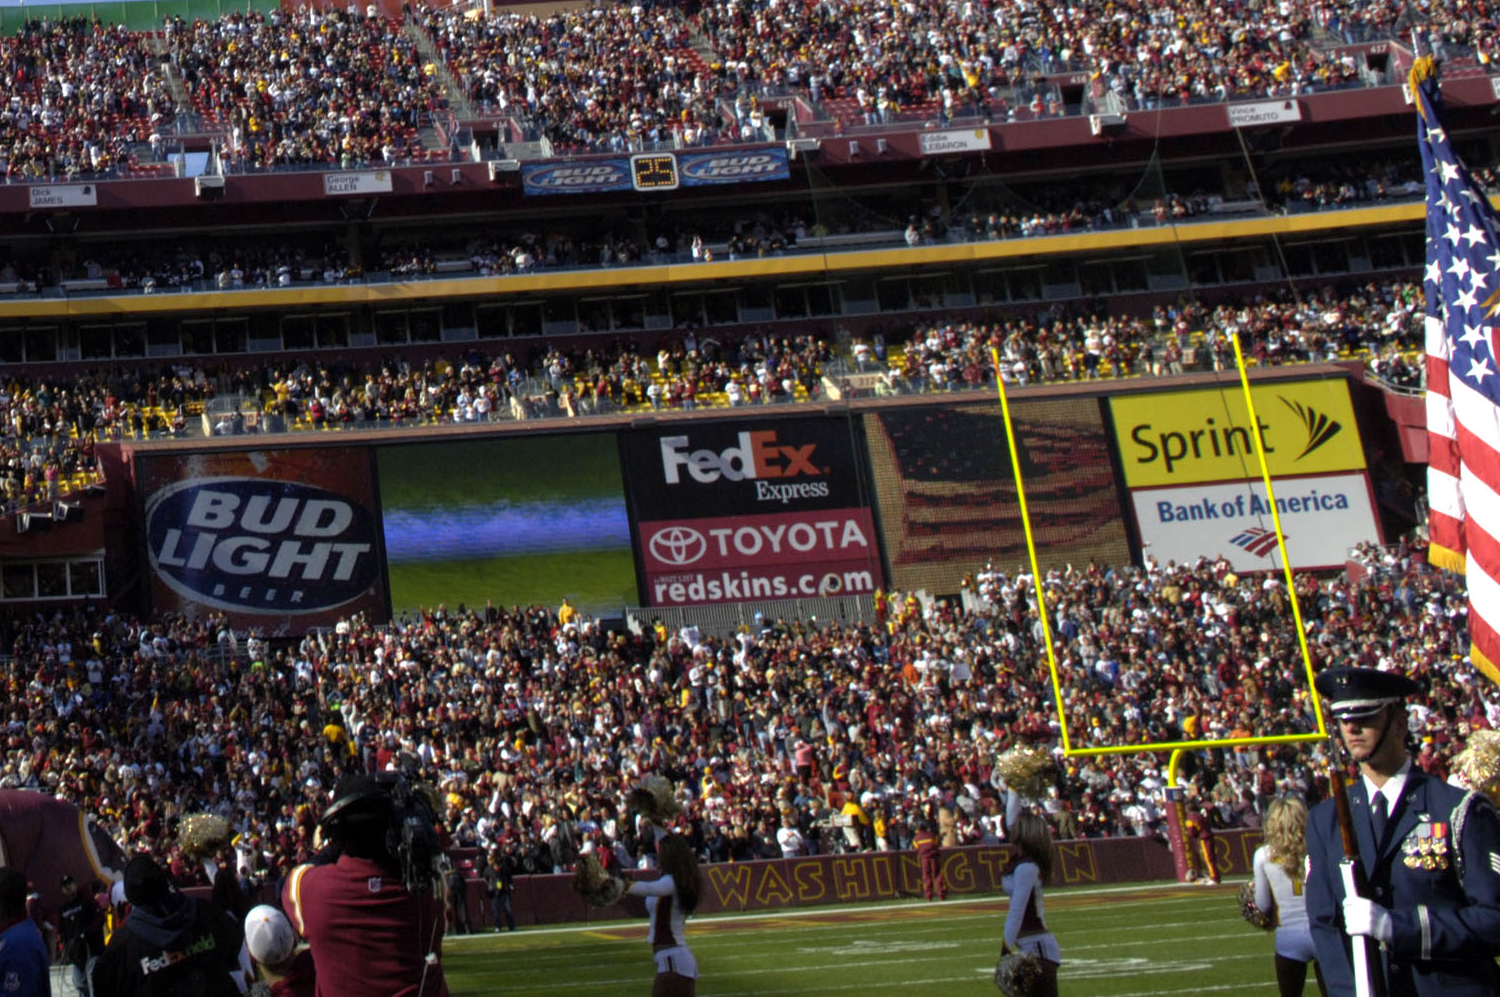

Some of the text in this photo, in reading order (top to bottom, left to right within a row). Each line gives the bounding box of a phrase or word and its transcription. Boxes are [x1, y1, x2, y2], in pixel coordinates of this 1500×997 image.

[1231, 107, 1256, 115] Vince
[1231, 112, 1279, 124] PROMUTO
[707, 155, 771, 166] BUD
[551, 166, 613, 177] BUD
[636, 158, 675, 186] 25
[696, 162, 783, 176] LIGHT
[328, 176, 360, 184] George
[540, 173, 626, 185] LIGHT
[32, 188, 51, 197] Dick
[328, 184, 357, 192] ALLEN
[33, 196, 64, 205] JAMES
[1131, 415, 1275, 474] Sprint
[660, 430, 821, 485] FedEx
[756, 481, 829, 503] Express
[186, 490, 353, 537] BUD
[1156, 489, 1349, 522] Bank of America
[709, 519, 868, 557] TOYOTA
[158, 528, 371, 581] LIGHT
[212, 584, 304, 603] BEER
[707, 843, 1096, 908] WASHINGTN
